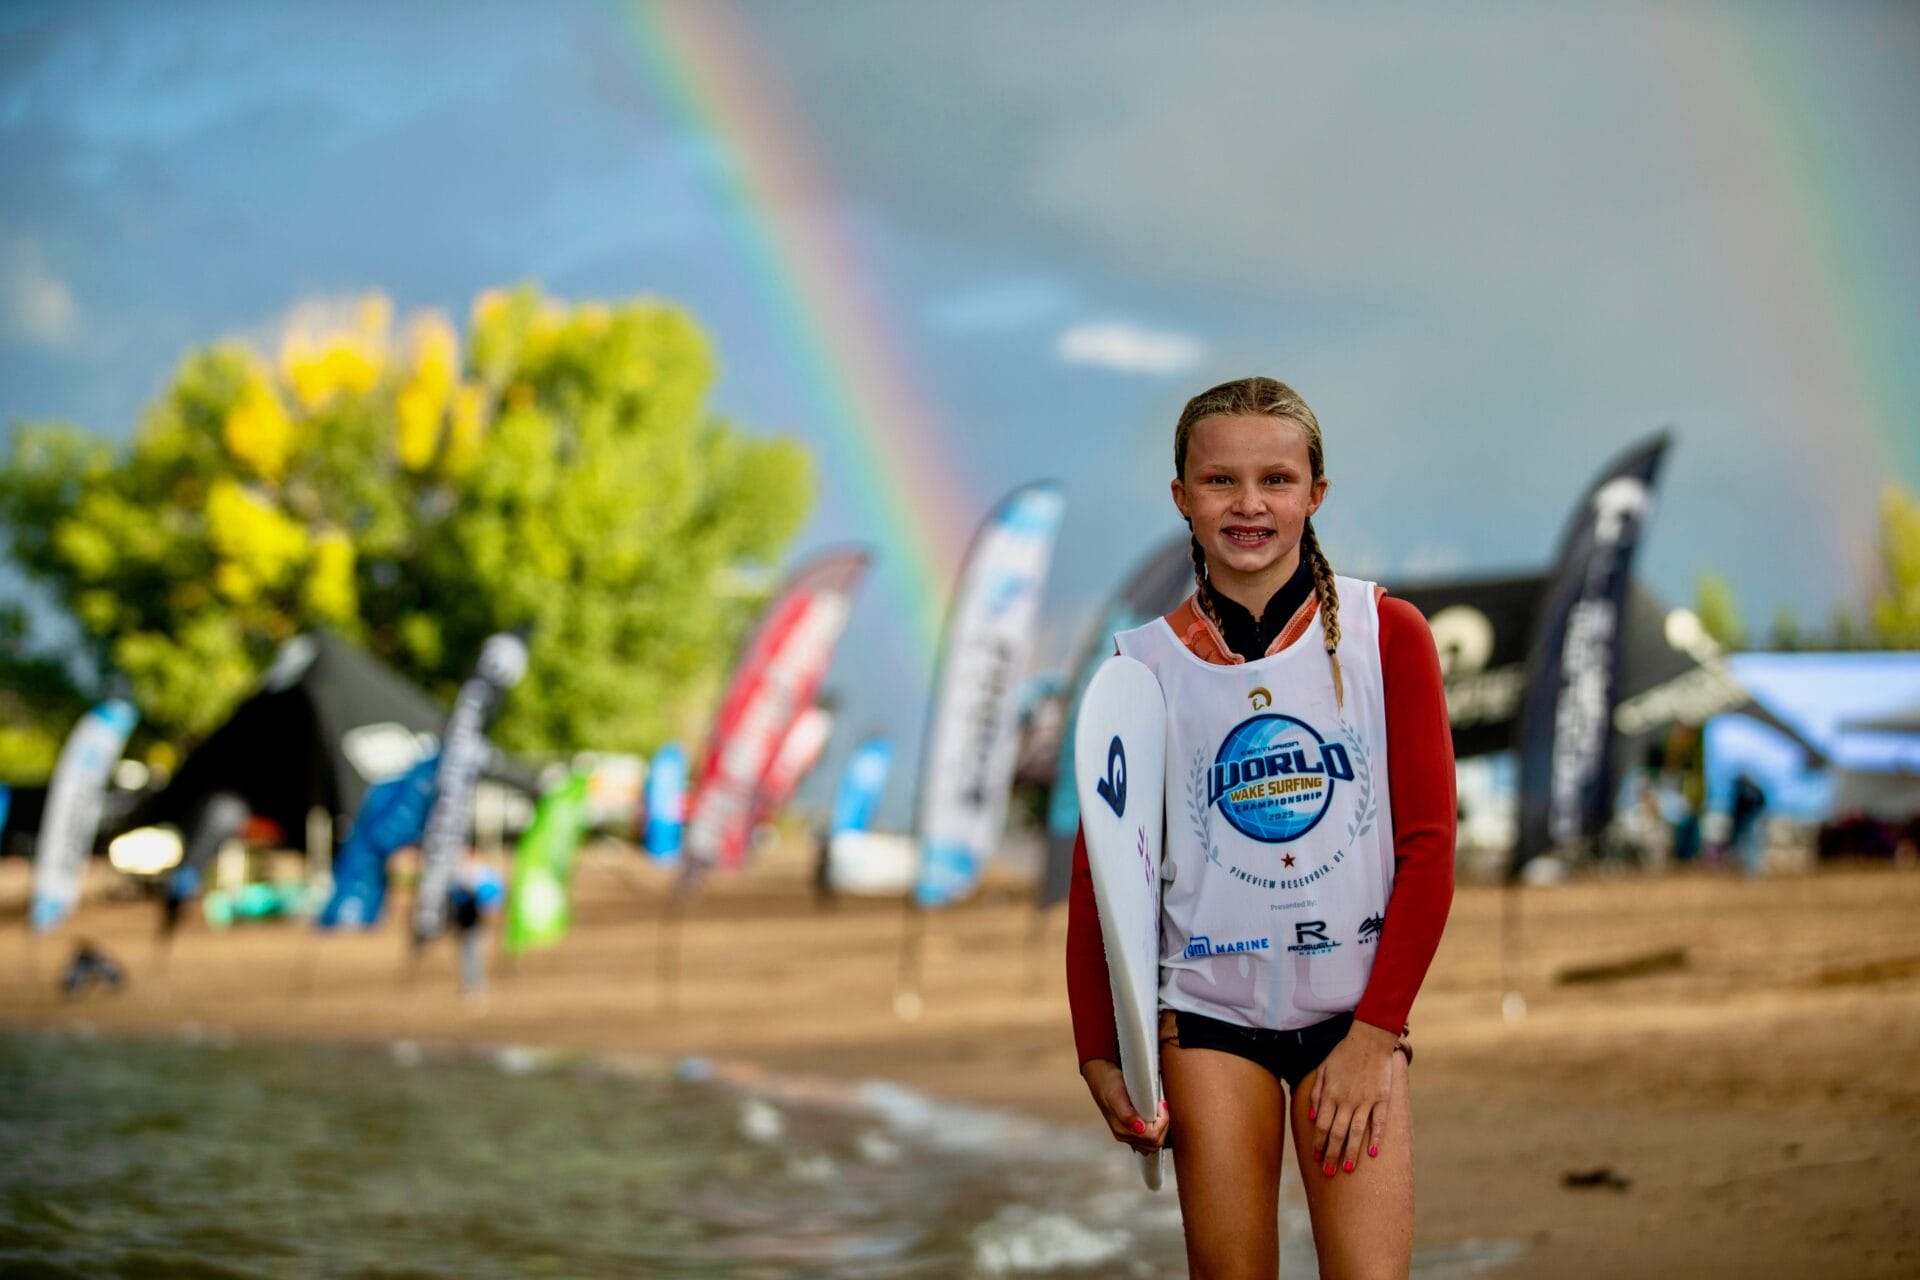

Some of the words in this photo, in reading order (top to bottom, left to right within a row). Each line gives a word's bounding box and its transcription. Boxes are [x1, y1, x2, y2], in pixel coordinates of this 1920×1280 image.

[1207, 743, 1355, 808] WORLD
[1231, 784, 1265, 802] WAKE
[1268, 777, 1322, 796] SURFING
[1235, 791, 1322, 812] CHAMPIONSHIP
[1269, 811, 1294, 821] 2023
[1229, 866, 1276, 889] PINEVIEW
[1333, 851, 1345, 864] UT
[1270, 901, 1306, 911] Presented
[1215, 938, 1269, 953] MARINE
[1287, 941, 1342, 952] ROSWELL
